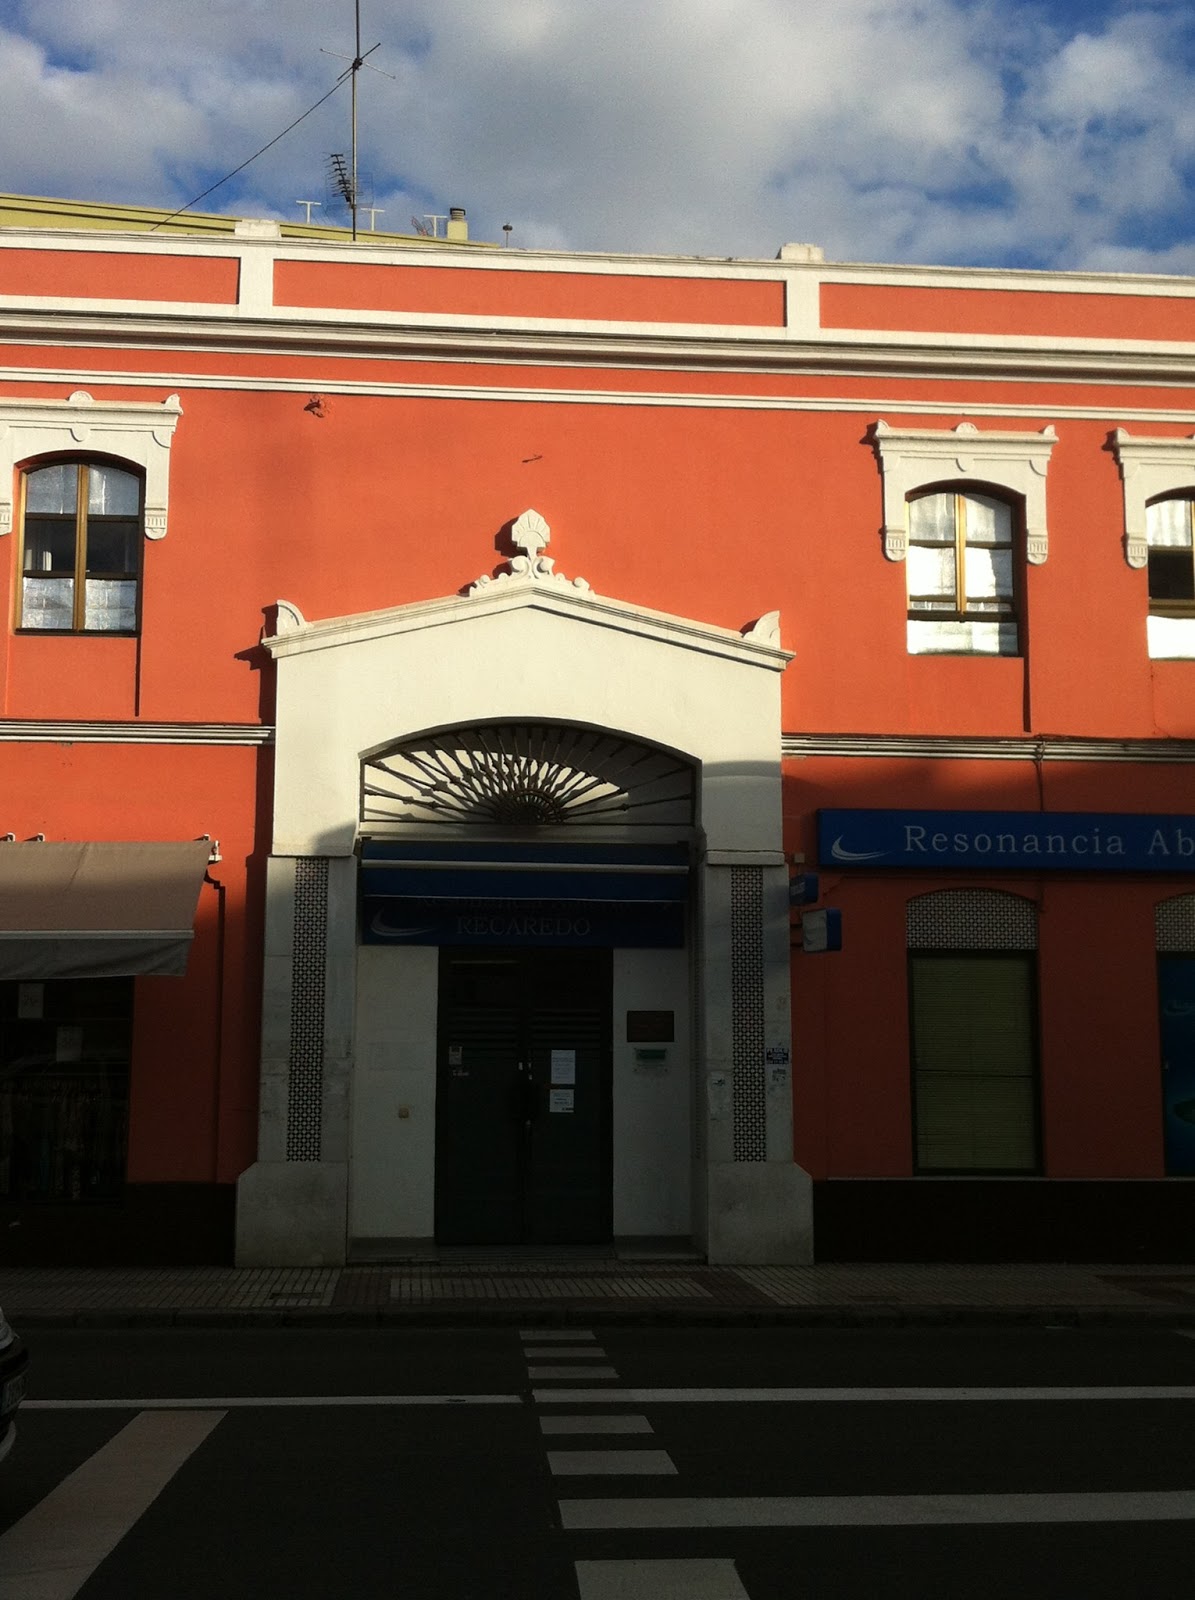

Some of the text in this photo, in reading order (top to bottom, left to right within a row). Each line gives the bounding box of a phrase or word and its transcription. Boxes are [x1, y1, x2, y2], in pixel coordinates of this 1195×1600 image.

[904, 825, 1195, 856] Resonancia Ab
[456, 917, 592, 936] RECAREDO
